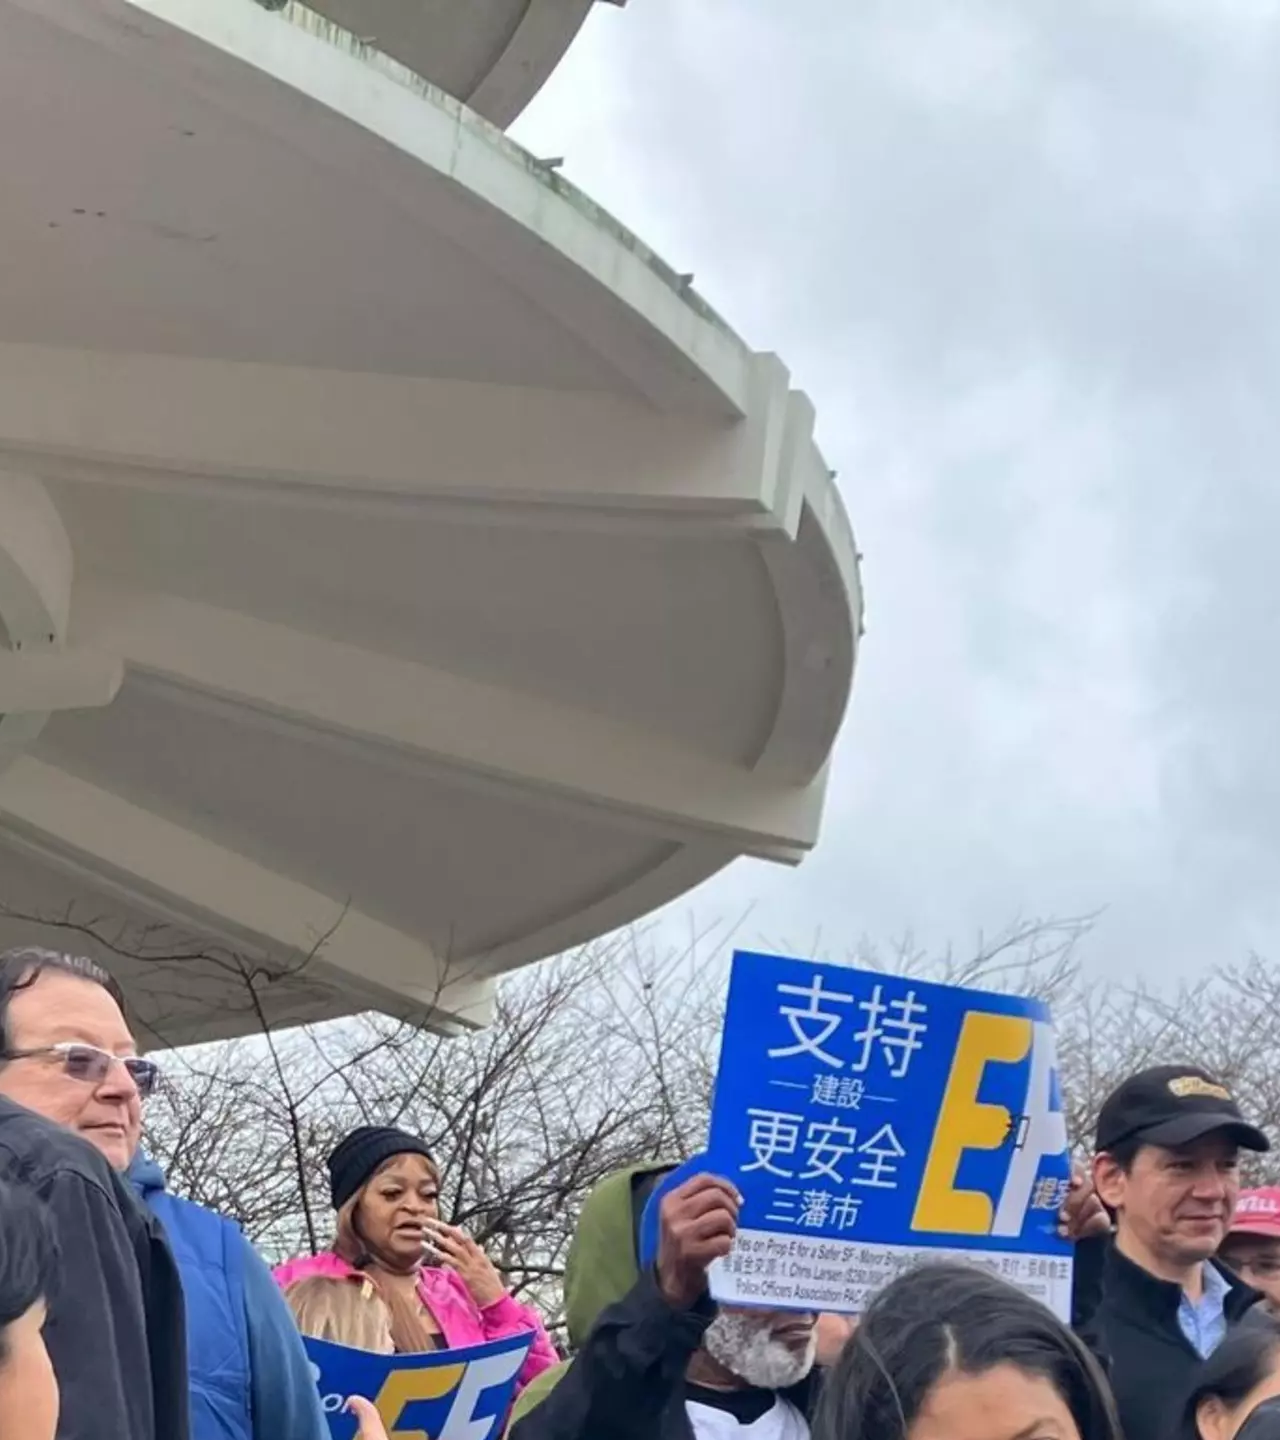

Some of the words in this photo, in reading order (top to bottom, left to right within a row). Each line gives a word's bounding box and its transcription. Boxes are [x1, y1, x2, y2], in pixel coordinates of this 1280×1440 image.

[767, 974, 928, 1078] 支持
[809, 1074, 866, 1111] 建設
[739, 1108, 907, 1189] 更安全
[764, 1188, 863, 1231] 三藩市
